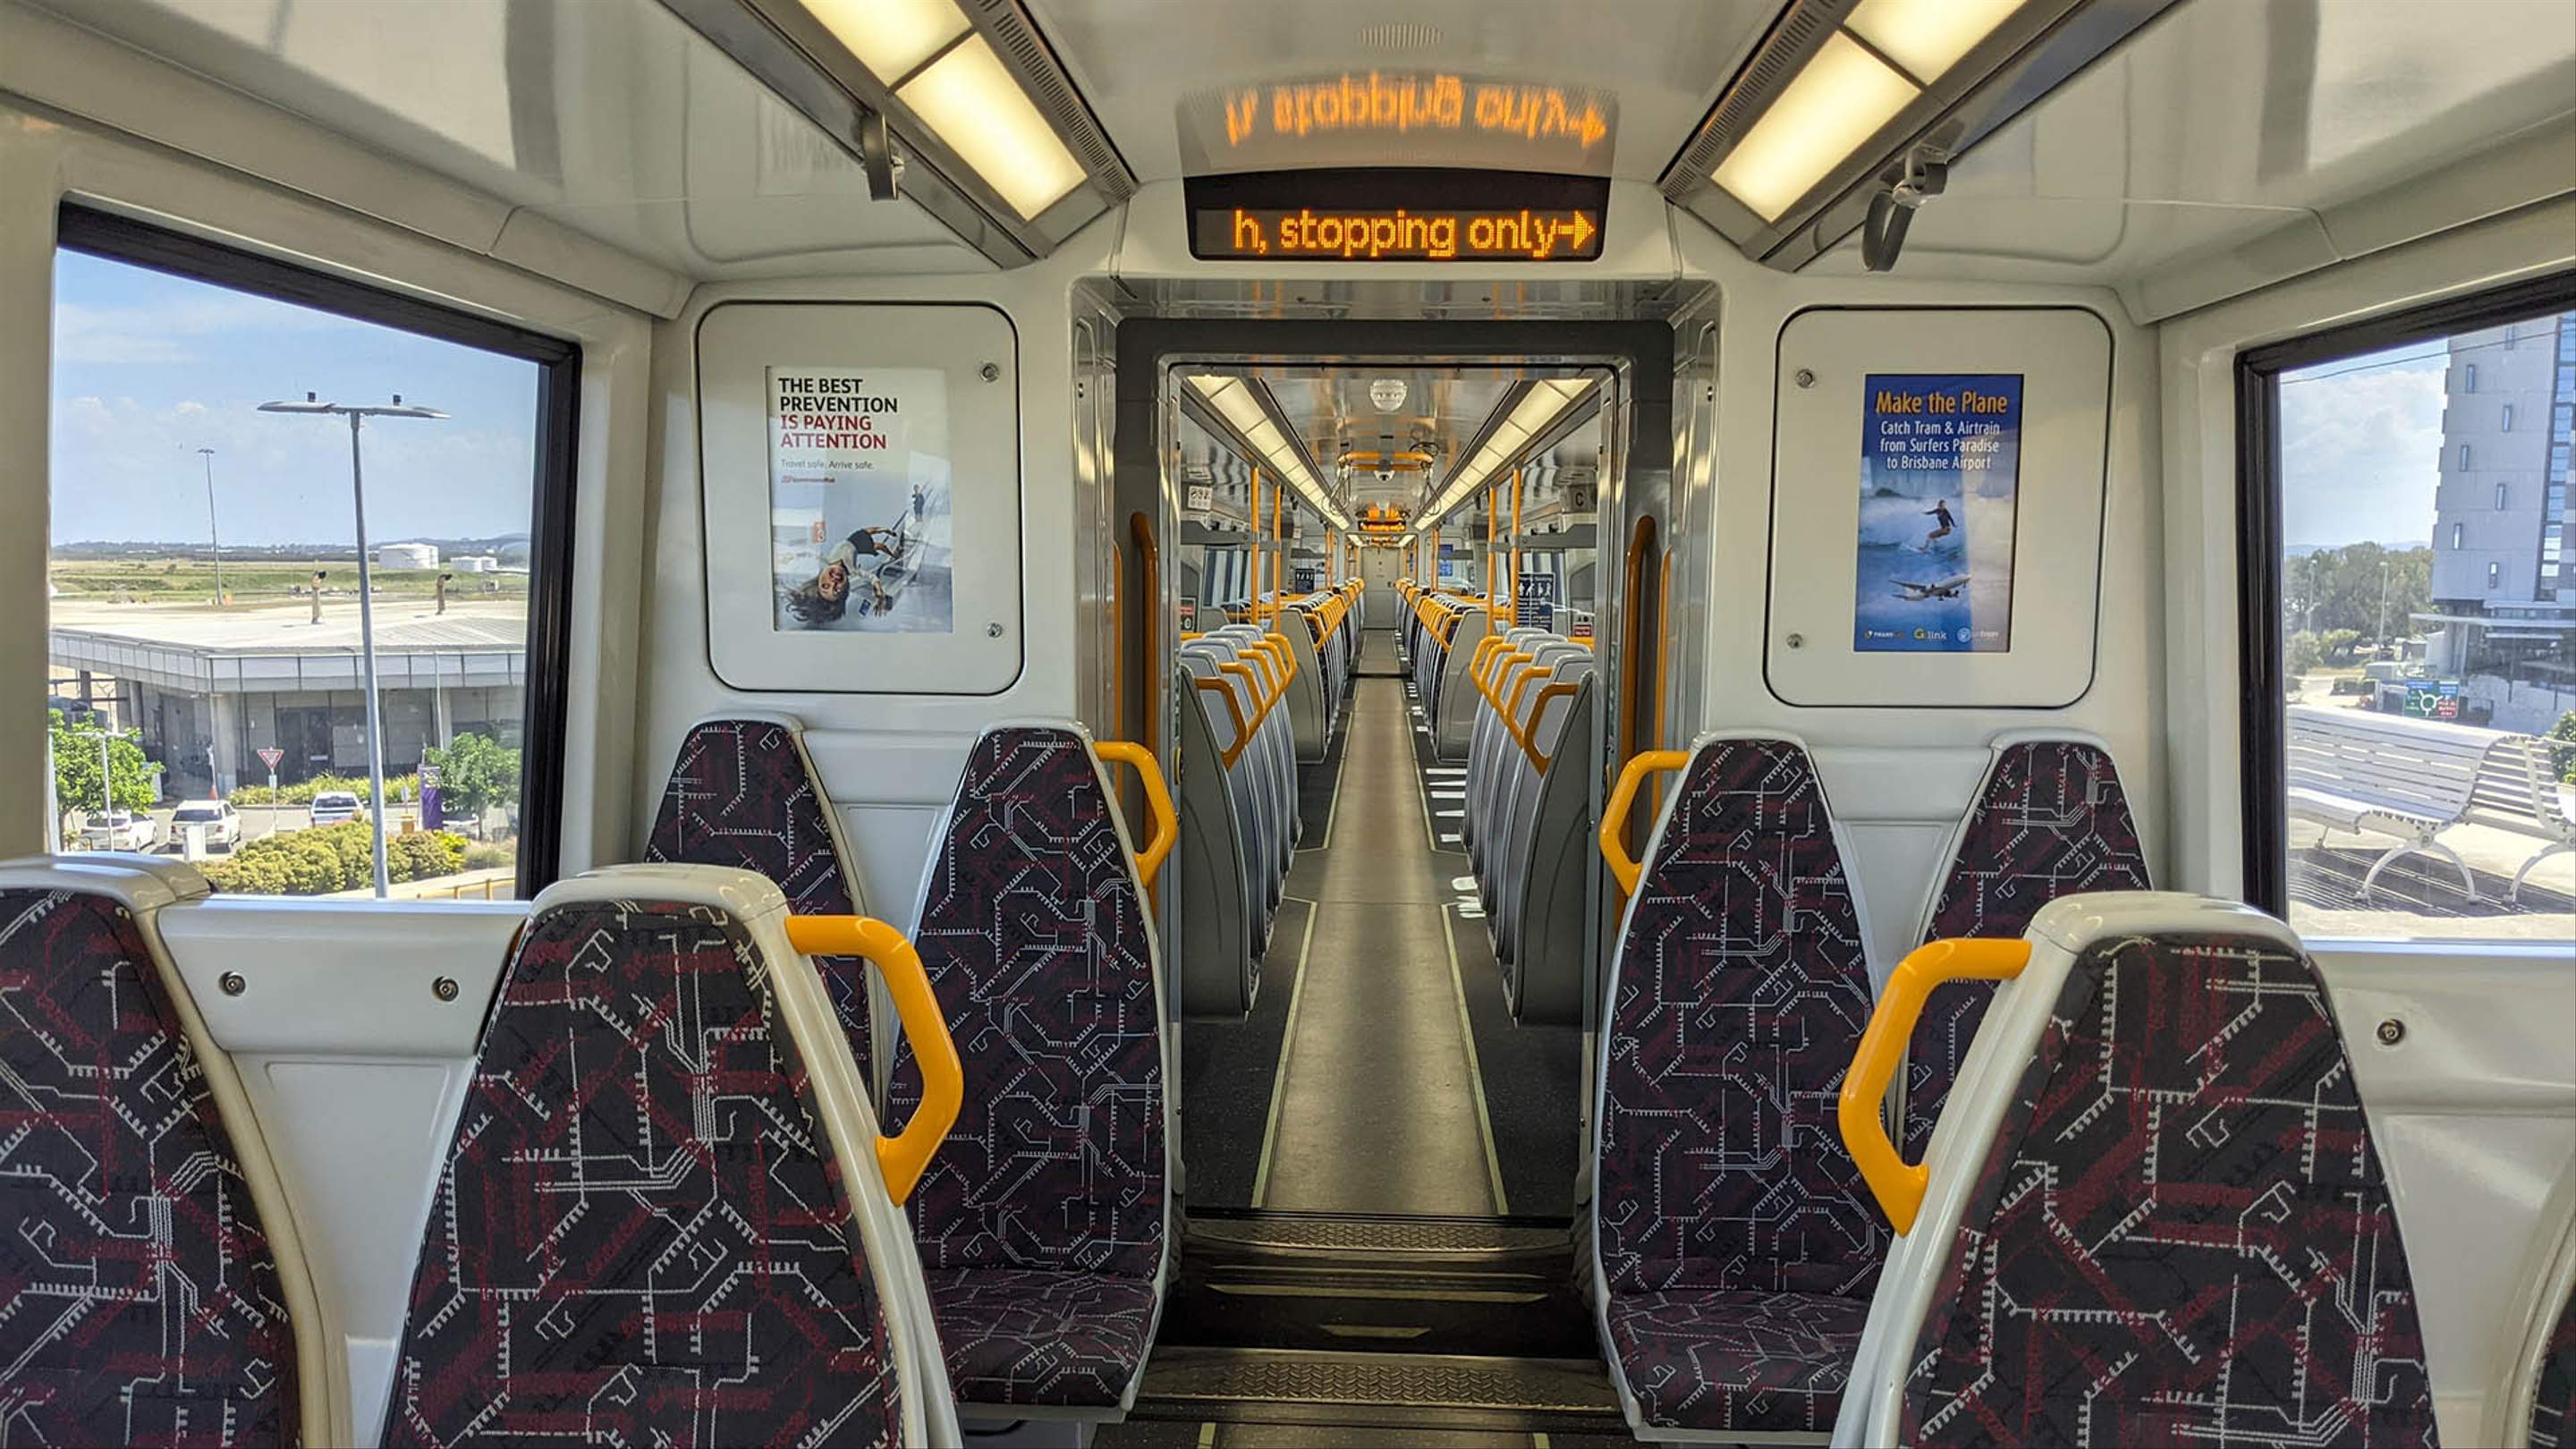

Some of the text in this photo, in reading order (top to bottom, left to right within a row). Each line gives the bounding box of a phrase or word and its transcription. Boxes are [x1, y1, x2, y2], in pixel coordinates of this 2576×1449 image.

[1233, 209, 1558, 258] h, stopping only
[778, 377, 863, 394] THE BEST
[780, 396, 898, 412] PREVENTION
[1875, 391, 2008, 414] Make the Plane
[781, 414, 871, 430] IS PAYING
[1881, 420, 2001, 436] Catch Tram & Airtrain
[781, 433, 886, 449] ATTENTION
[1880, 438, 2000, 453] from Surfers Paradise
[781, 459, 805, 469] Travel
[828, 461, 853, 470] Arrive
[1887, 455, 1991, 470] to Brisbane Airport
